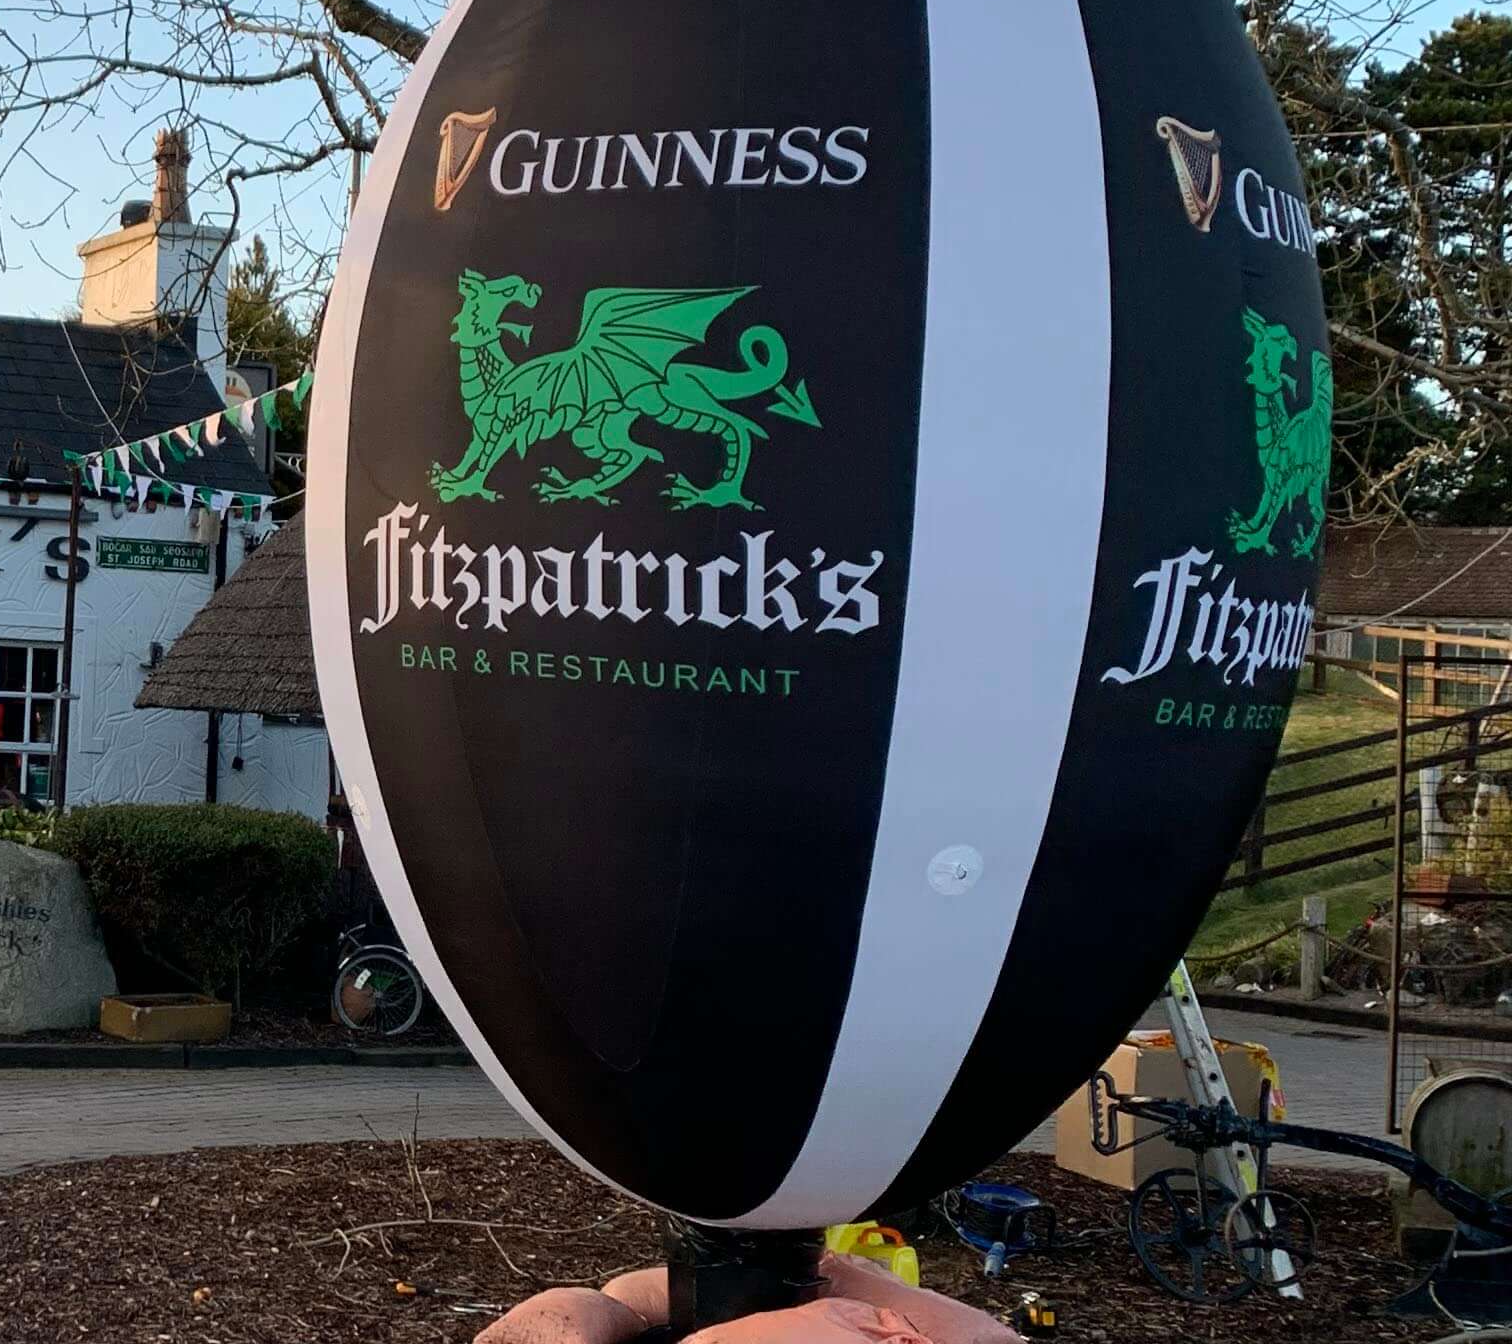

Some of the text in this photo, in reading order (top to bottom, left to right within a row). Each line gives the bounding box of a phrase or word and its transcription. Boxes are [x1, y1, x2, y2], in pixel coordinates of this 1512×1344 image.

[489, 126, 869, 194] GUINNESS
[128, 555, 165, 566] JOSEPH
[173, 557, 199, 568] ROAD
[360, 501, 884, 636] Fitzpatrick's
[401, 645, 800, 696] BAR & RESTAURANT
[1155, 698, 1215, 728] BAR
[1223, 706, 1235, 729] &
